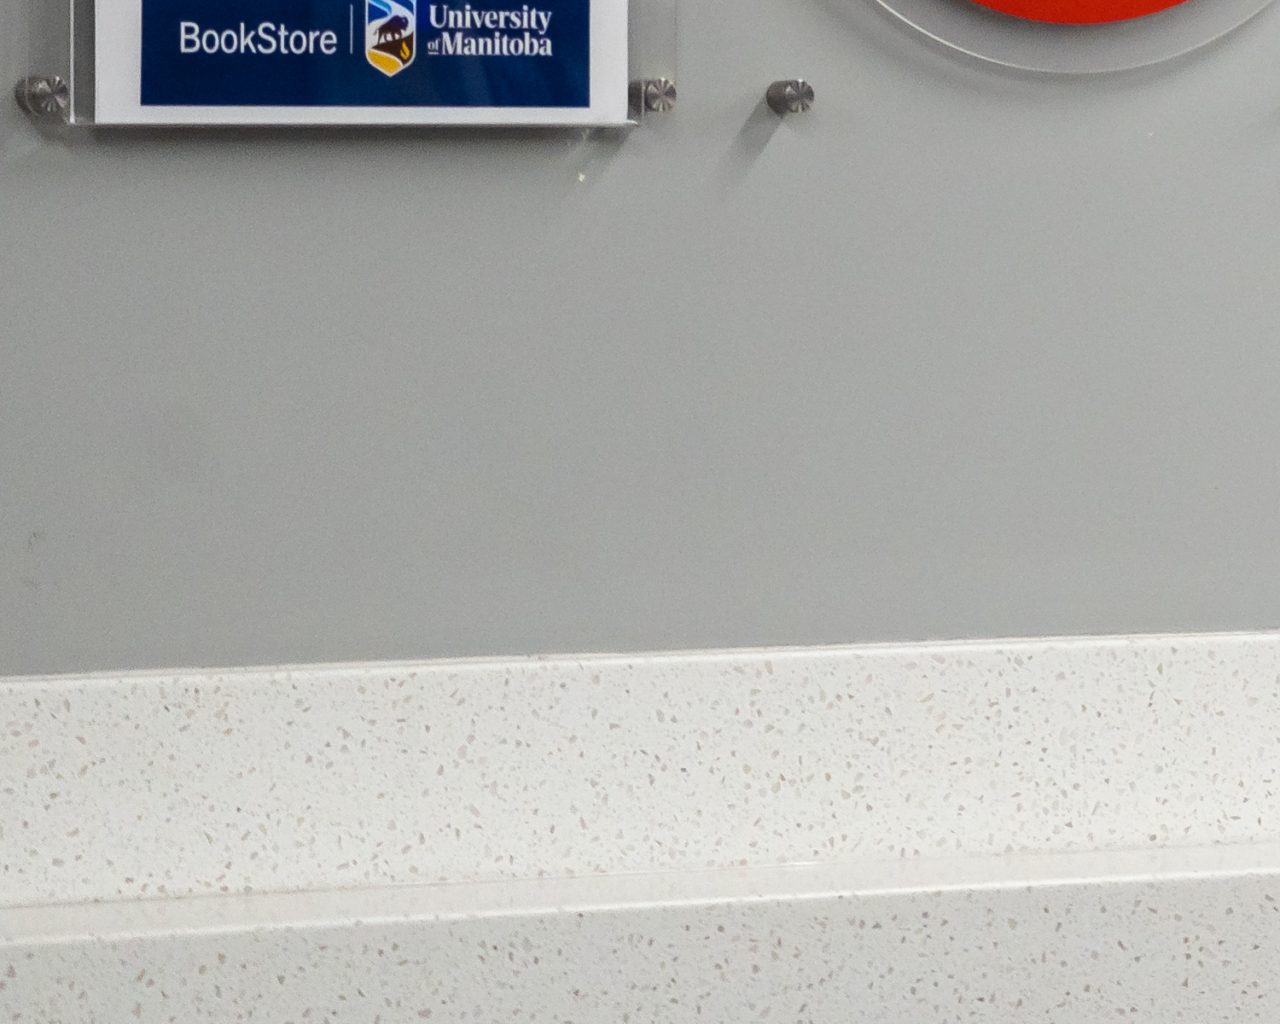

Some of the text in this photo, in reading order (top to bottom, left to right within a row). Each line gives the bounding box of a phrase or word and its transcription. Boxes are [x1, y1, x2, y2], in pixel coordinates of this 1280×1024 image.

[430, 5, 551, 34] University
[180, 22, 337, 54] BookStore
[427, 32, 552, 56] of Manitoba
